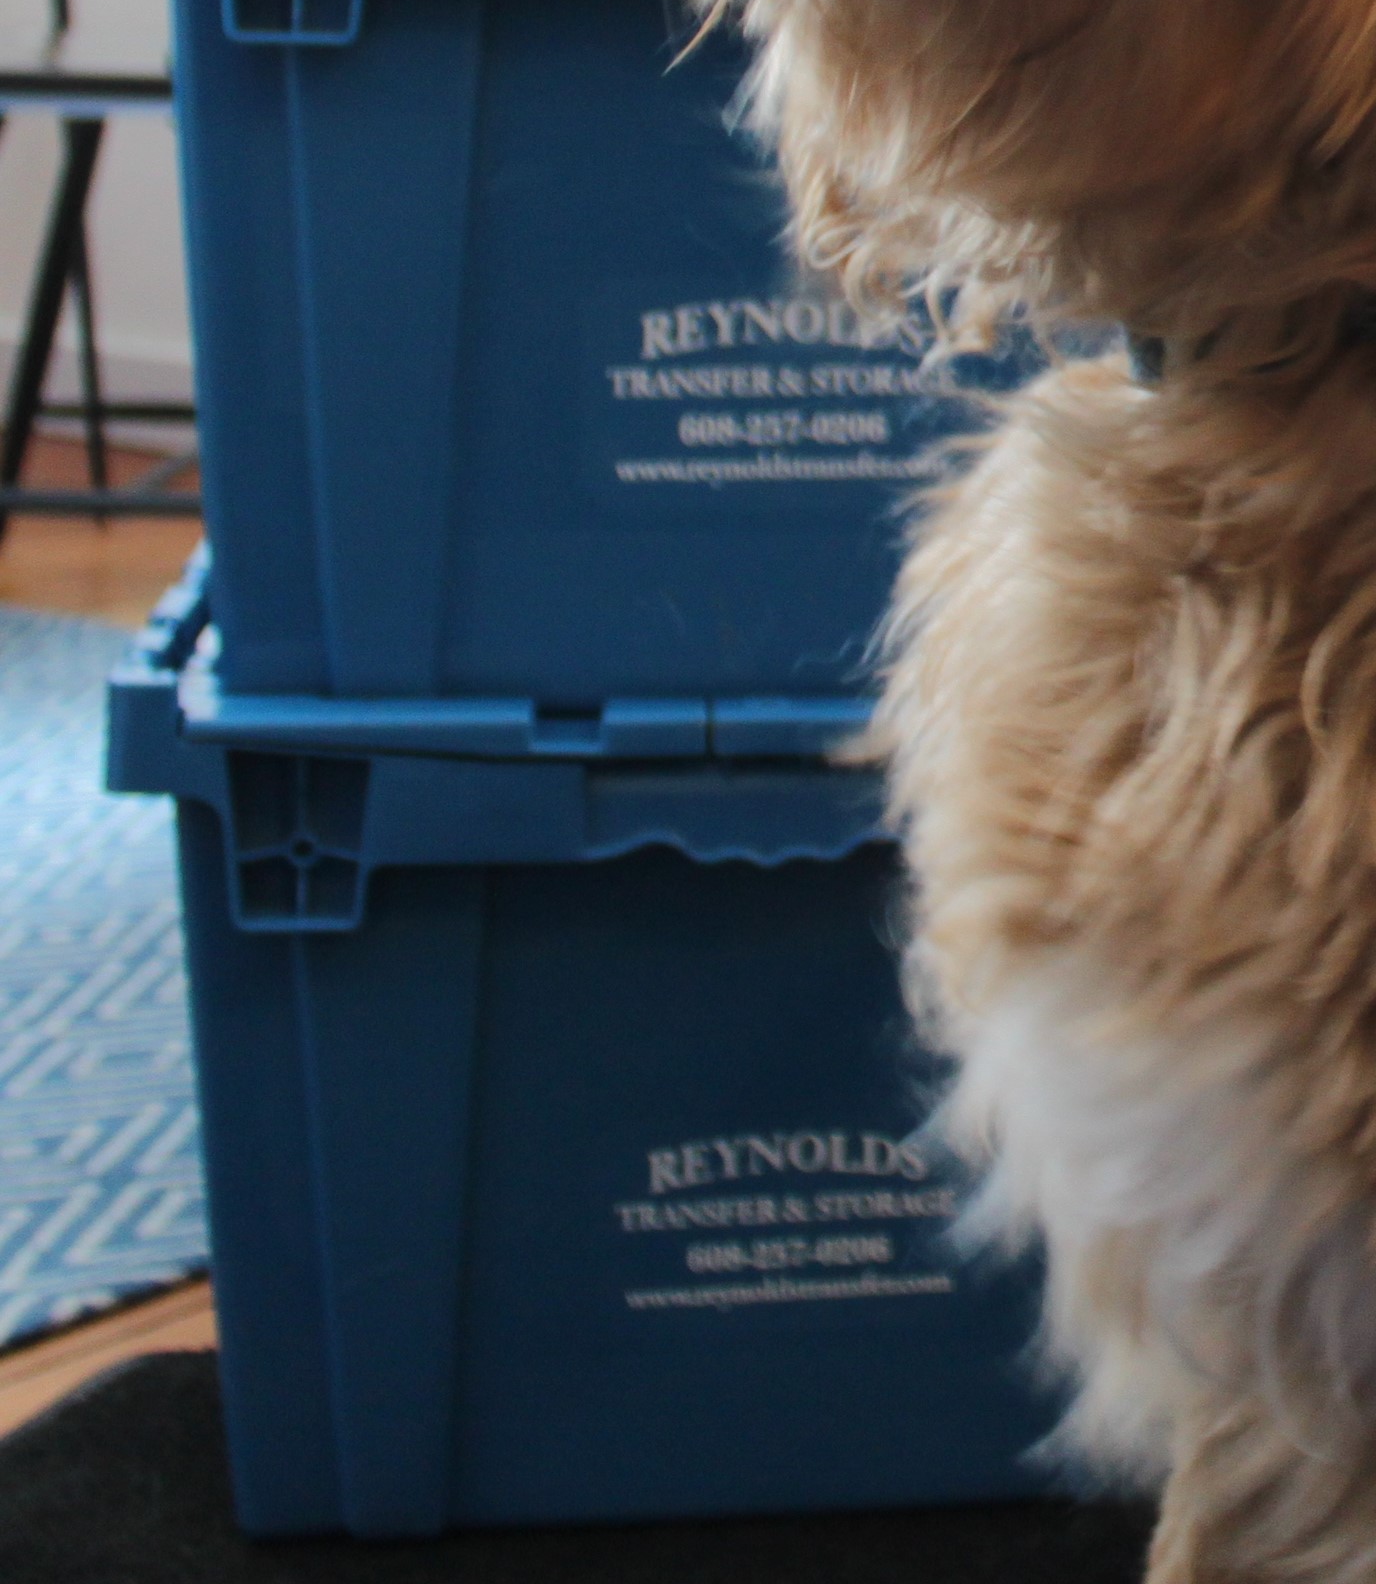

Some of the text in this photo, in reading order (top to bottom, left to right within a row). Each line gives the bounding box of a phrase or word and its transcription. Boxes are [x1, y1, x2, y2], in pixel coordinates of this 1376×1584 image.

[641, 298, 926, 359] REYNOLS
[607, 366, 772, 399] TRANSFER
[777, 367, 801, 397] &
[647, 1132, 929, 1194] REYNOLDS
[614, 1196, 777, 1233] TRANSFER
[783, 1194, 808, 1223] &
